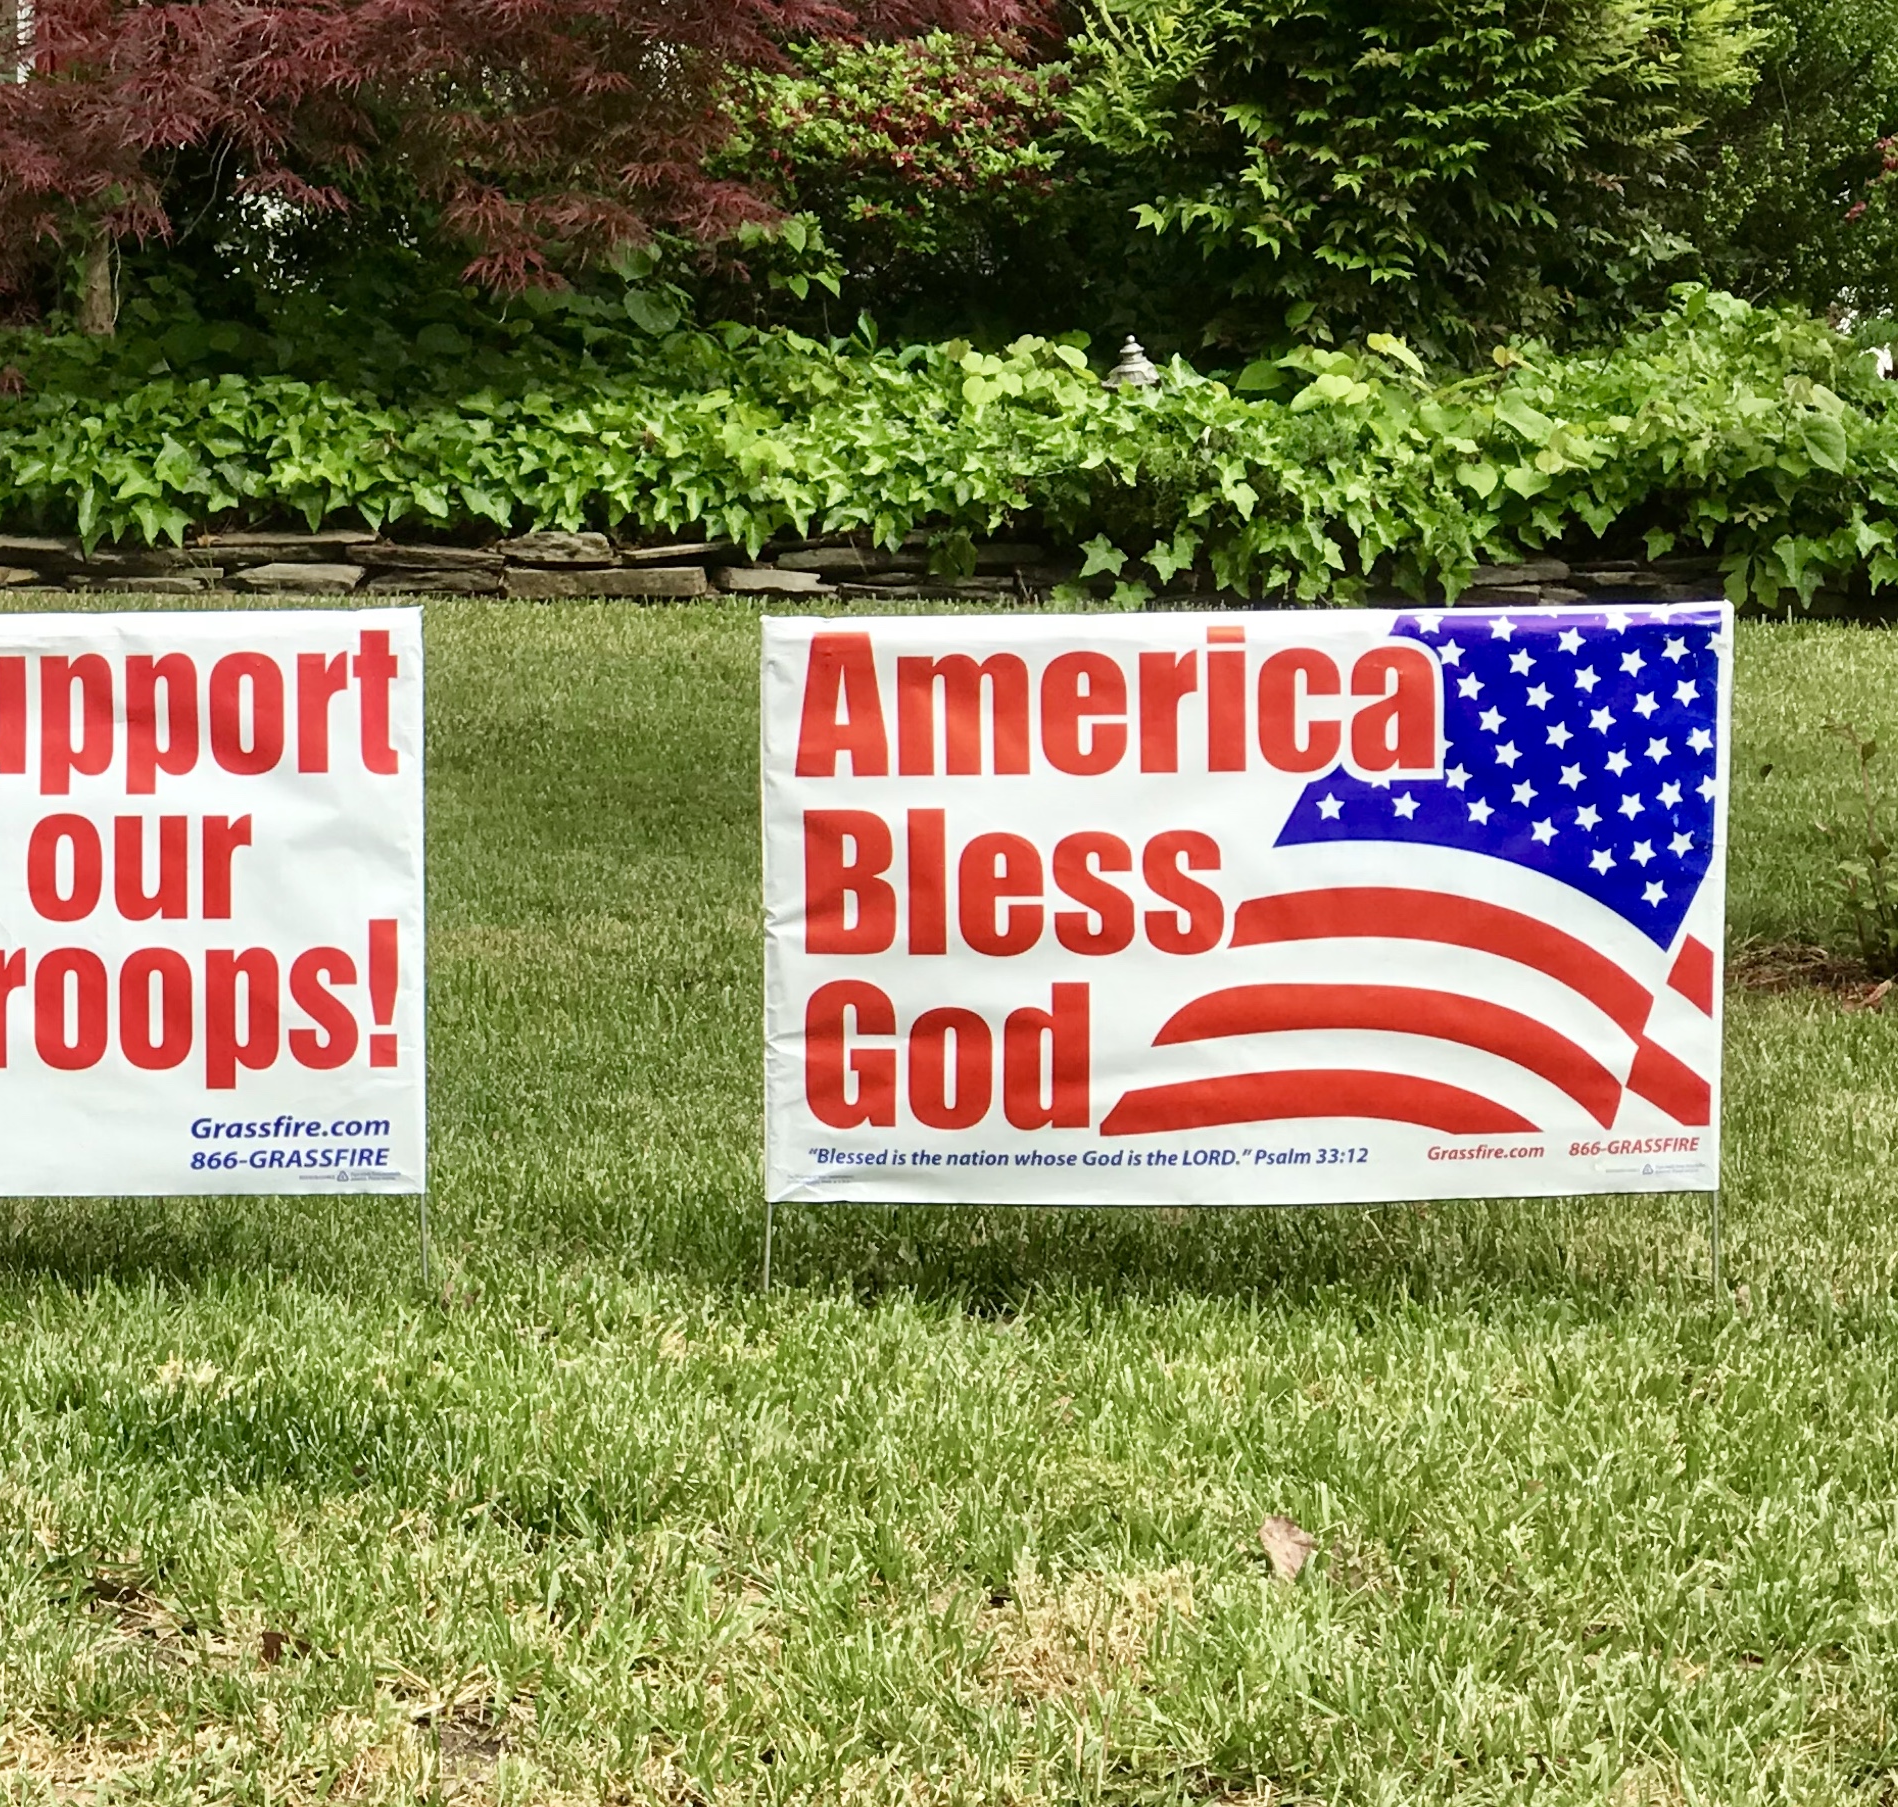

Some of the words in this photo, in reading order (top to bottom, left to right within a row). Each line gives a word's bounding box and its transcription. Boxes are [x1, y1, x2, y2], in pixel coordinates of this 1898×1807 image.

[794, 626, 1435, 778] America
[27, 813, 252, 923] our
[803, 808, 1225, 958] Bless
[804, 979, 1091, 1131] God
[190, 1116, 391, 1141] Grassfire.com
[190, 1147, 389, 1170] 866-GRASSFIRE
[808, 1148, 888, 1166] “Blessed
[891, 1149, 907, 1166] is
[911, 1150, 942, 1166] the
[946, 1149, 1010, 1167] nation
[1014, 1150, 1077, 1167] whose
[1082, 1149, 1123, 1167] God
[1127, 1149, 1142, 1167] is
[1146, 1149, 1178, 1166] the
[1182, 1149, 1252, 1167] LORD.”
[1254, 1148, 1311, 1165] Psalm
[1315, 1147, 1369, 1164] 33:12
[1426, 1143, 1545, 1161] Grassfire.com
[1568, 1136, 1701, 1156] 866-GRASSFIRE
